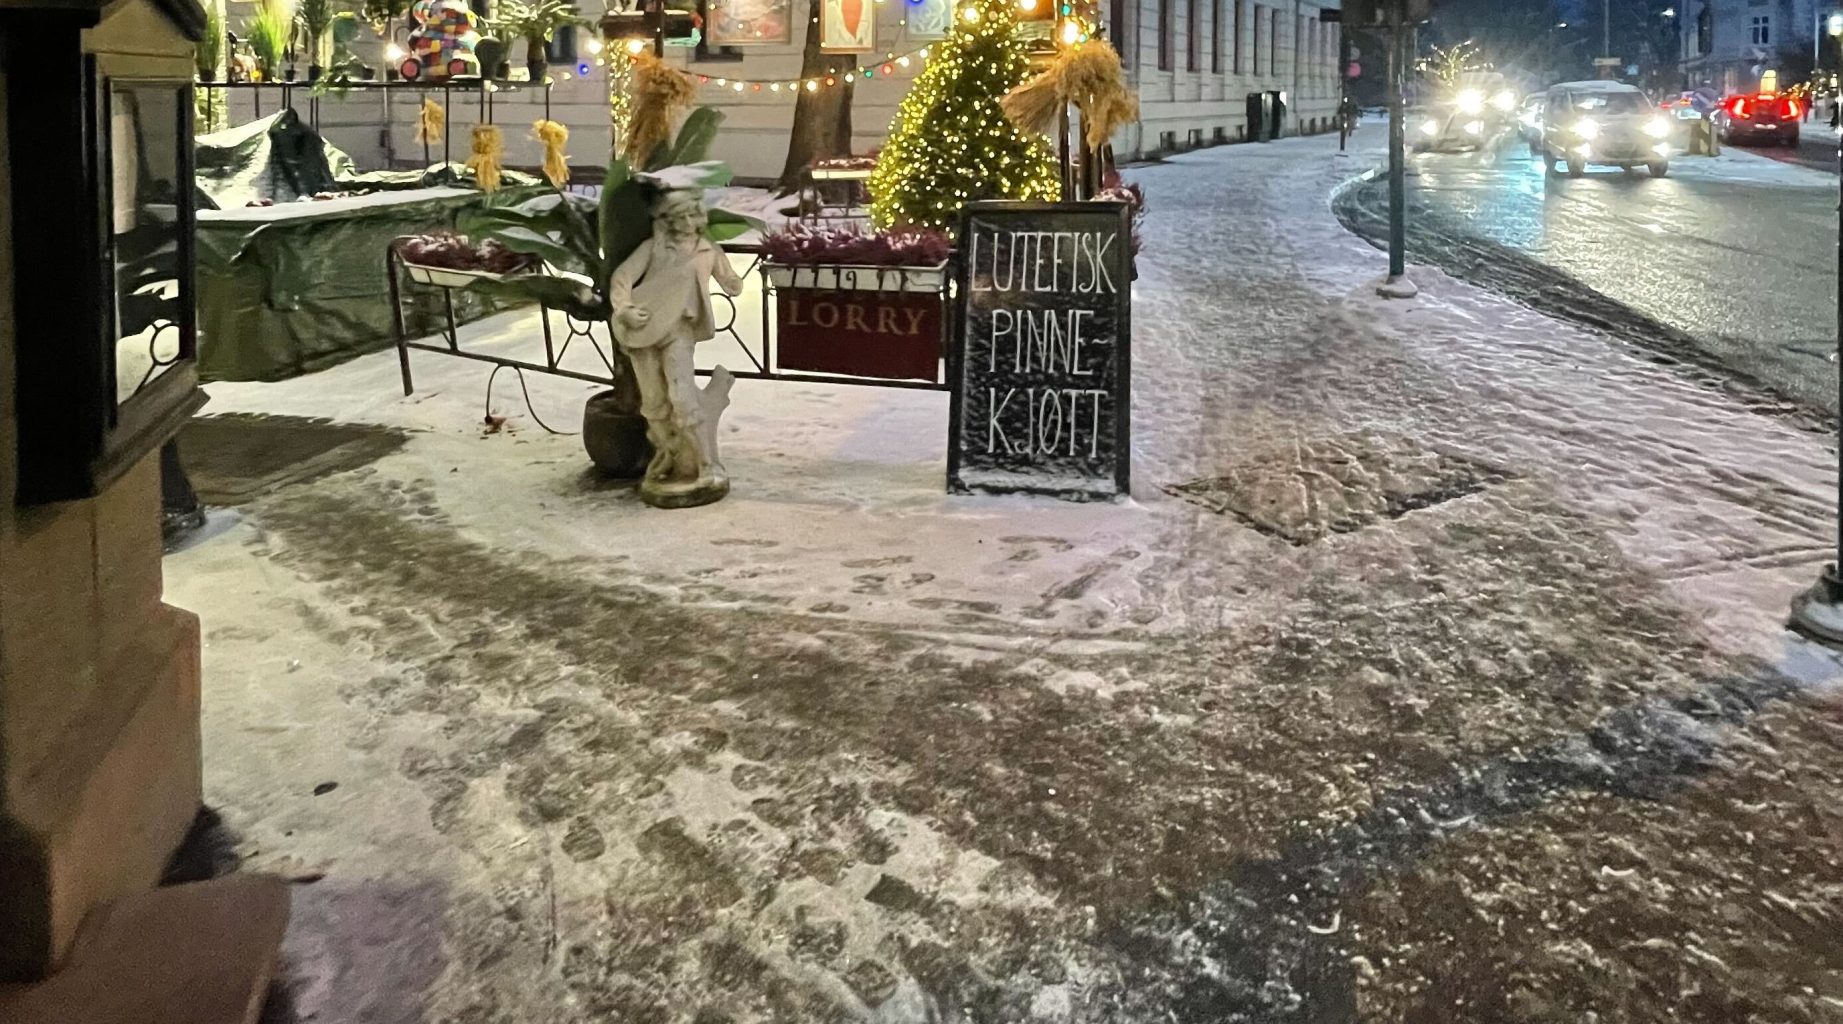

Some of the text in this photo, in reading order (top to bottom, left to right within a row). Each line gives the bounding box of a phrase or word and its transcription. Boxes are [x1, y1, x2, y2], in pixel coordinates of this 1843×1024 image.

[970, 231, 1117, 294] LUTEFISK
[786, 299, 927, 336] LORRY
[989, 308, 1110, 376] PINNE-
[987, 387, 1108, 458] KJØTT
